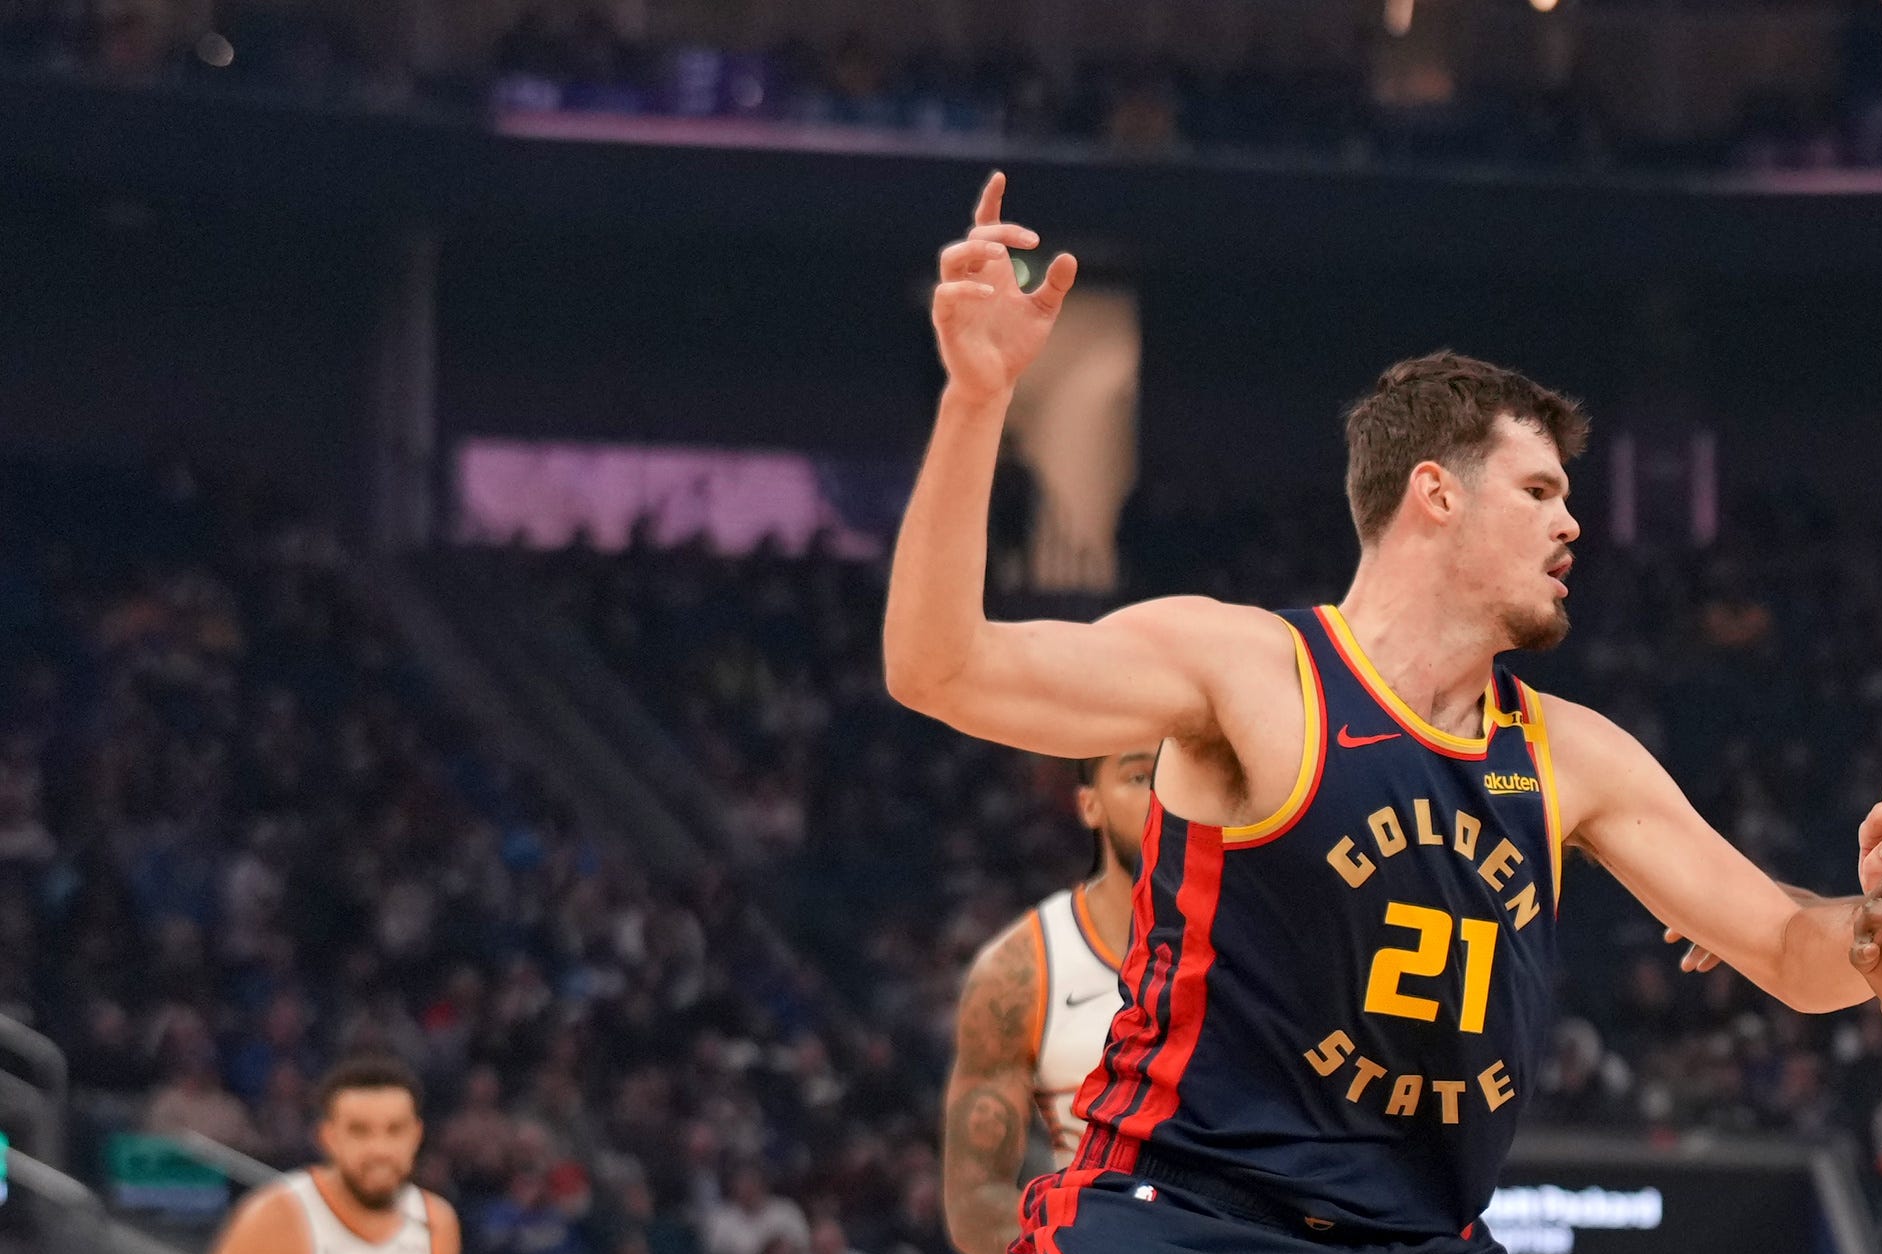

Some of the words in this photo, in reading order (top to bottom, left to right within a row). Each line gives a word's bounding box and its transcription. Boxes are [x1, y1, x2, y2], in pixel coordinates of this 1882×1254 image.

[1484, 772, 1540, 793] akuten
[1327, 799, 1540, 931] GOLDEN
[1364, 901, 1498, 1034] 21
[1304, 1029, 1516, 1124] STATE
